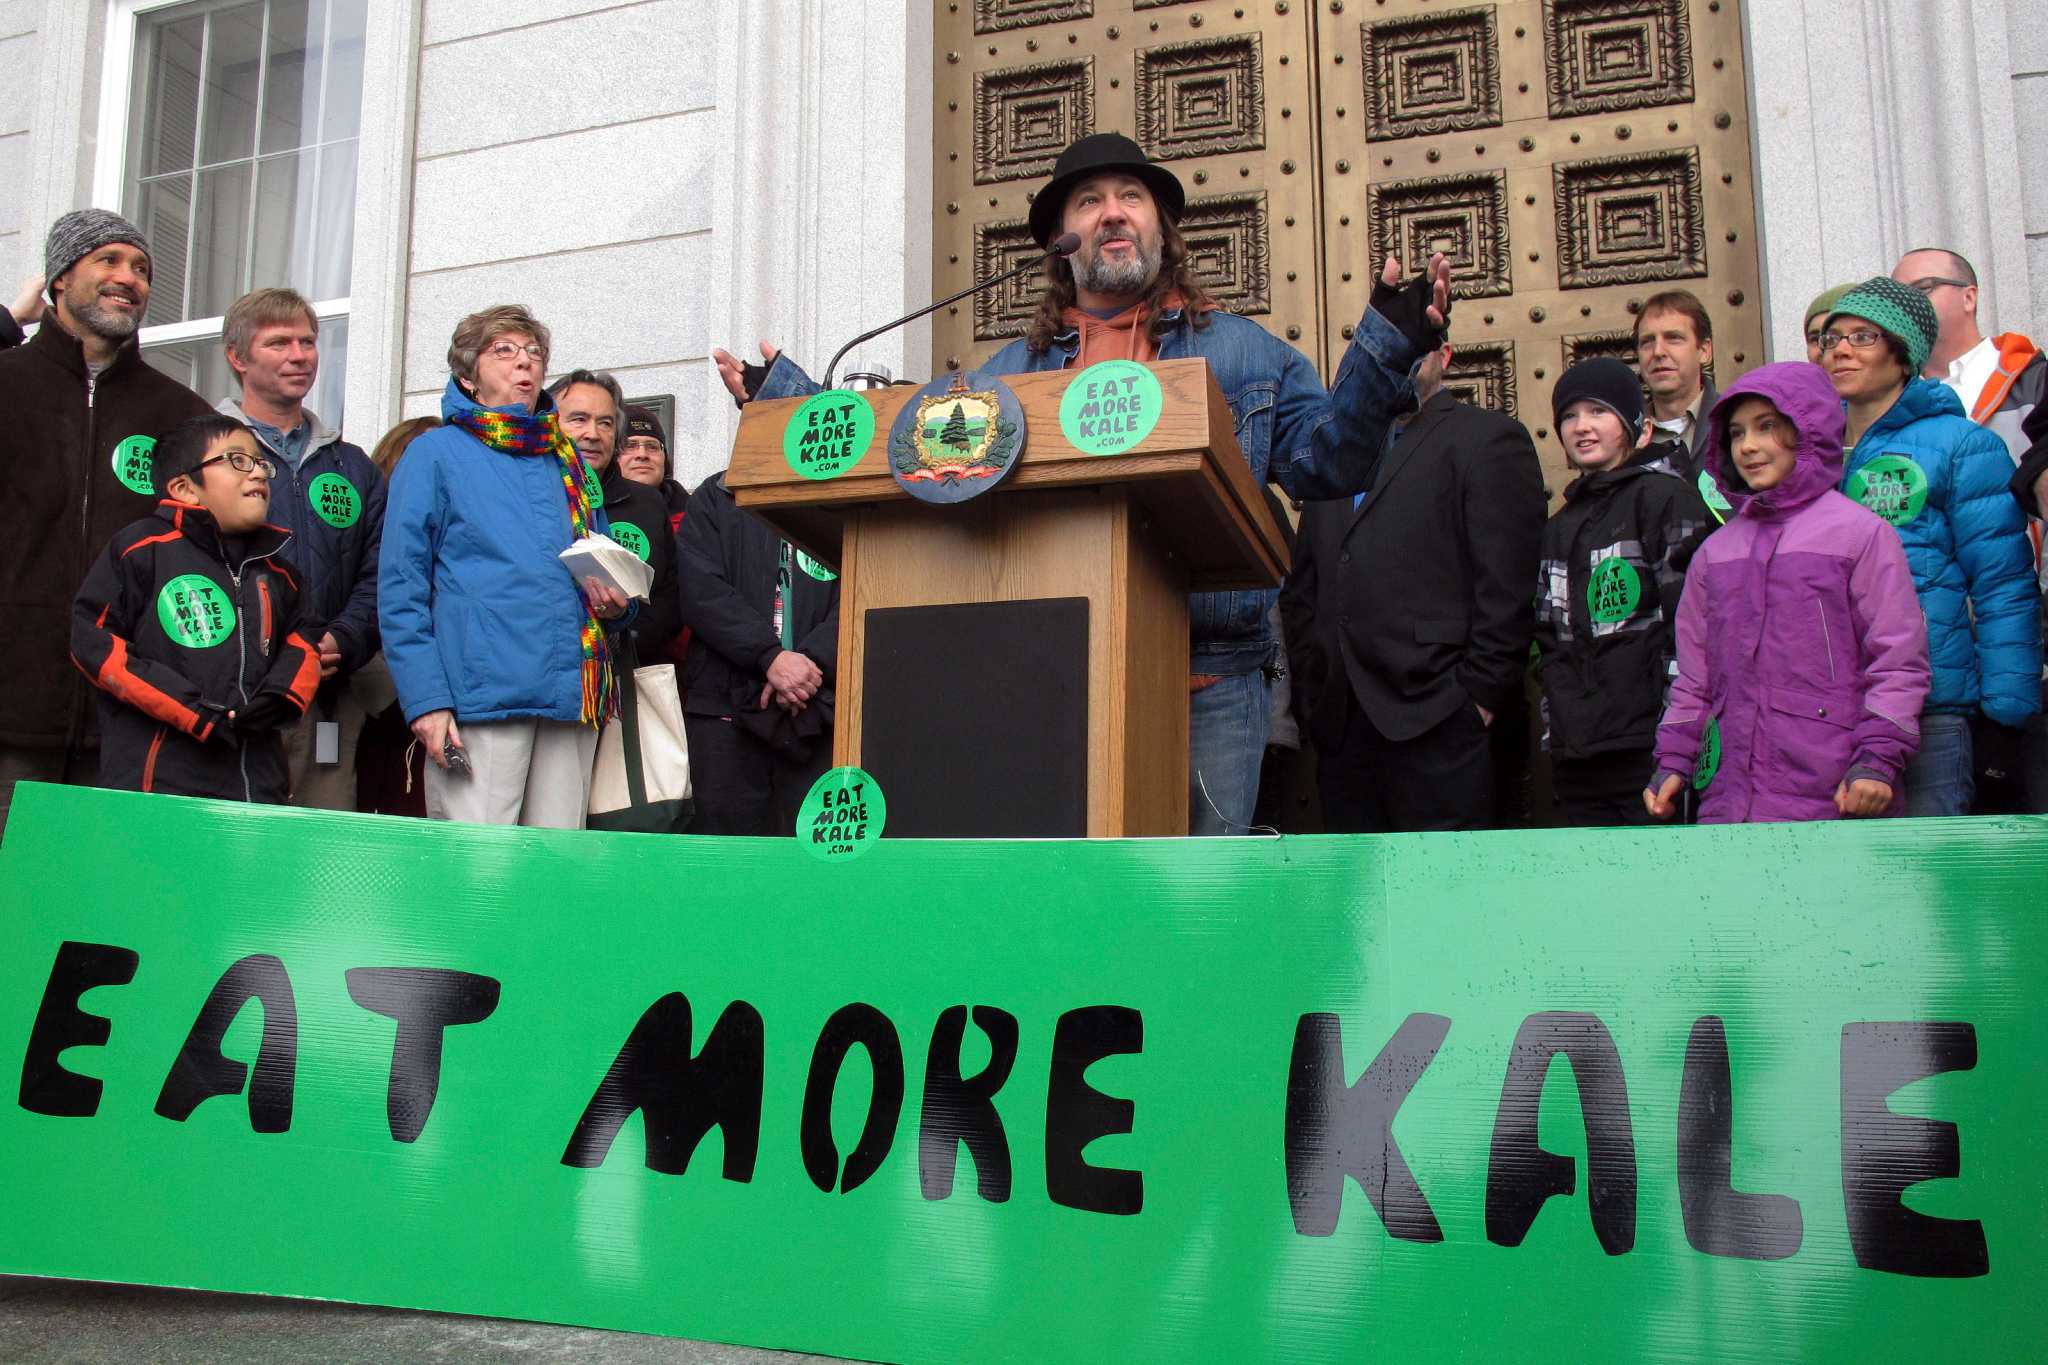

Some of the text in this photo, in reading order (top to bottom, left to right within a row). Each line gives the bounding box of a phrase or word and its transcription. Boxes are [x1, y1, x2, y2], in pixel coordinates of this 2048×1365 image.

[1086, 376, 1139, 400] EAT
[808, 404, 856, 427] EAT
[1078, 394, 1142, 419] MORE
[799, 421, 856, 446] MORE
[1079, 413, 1139, 438] KALE
[1096, 436, 1125, 447] .COM
[132, 446, 153, 461] EA
[800, 440, 853, 464] KALE
[125, 458, 150, 471] MO
[814, 462, 840, 472] .COM
[126, 469, 151, 482] KA
[1867, 468, 1910, 484] EAT
[322, 483, 349, 495] EAT
[1861, 482, 1911, 498] MORE
[320, 494, 352, 507] MORE
[322, 504, 352, 518] KALE
[614, 529, 641, 542] EAT
[1596, 565, 1622, 587] EAT
[174, 587, 214, 605] EAT
[1594, 578, 1628, 600] MORE
[175, 601, 222, 621] MORE
[1594, 592, 1629, 613] KALE
[177, 616, 225, 637] KALE
[822, 783, 864, 809] EAT
[811, 802, 868, 826] MORE
[812, 823, 867, 844] KALE
[826, 844, 854, 855] .COM
[18, 941, 1990, 1278] EAT MORE KALE
